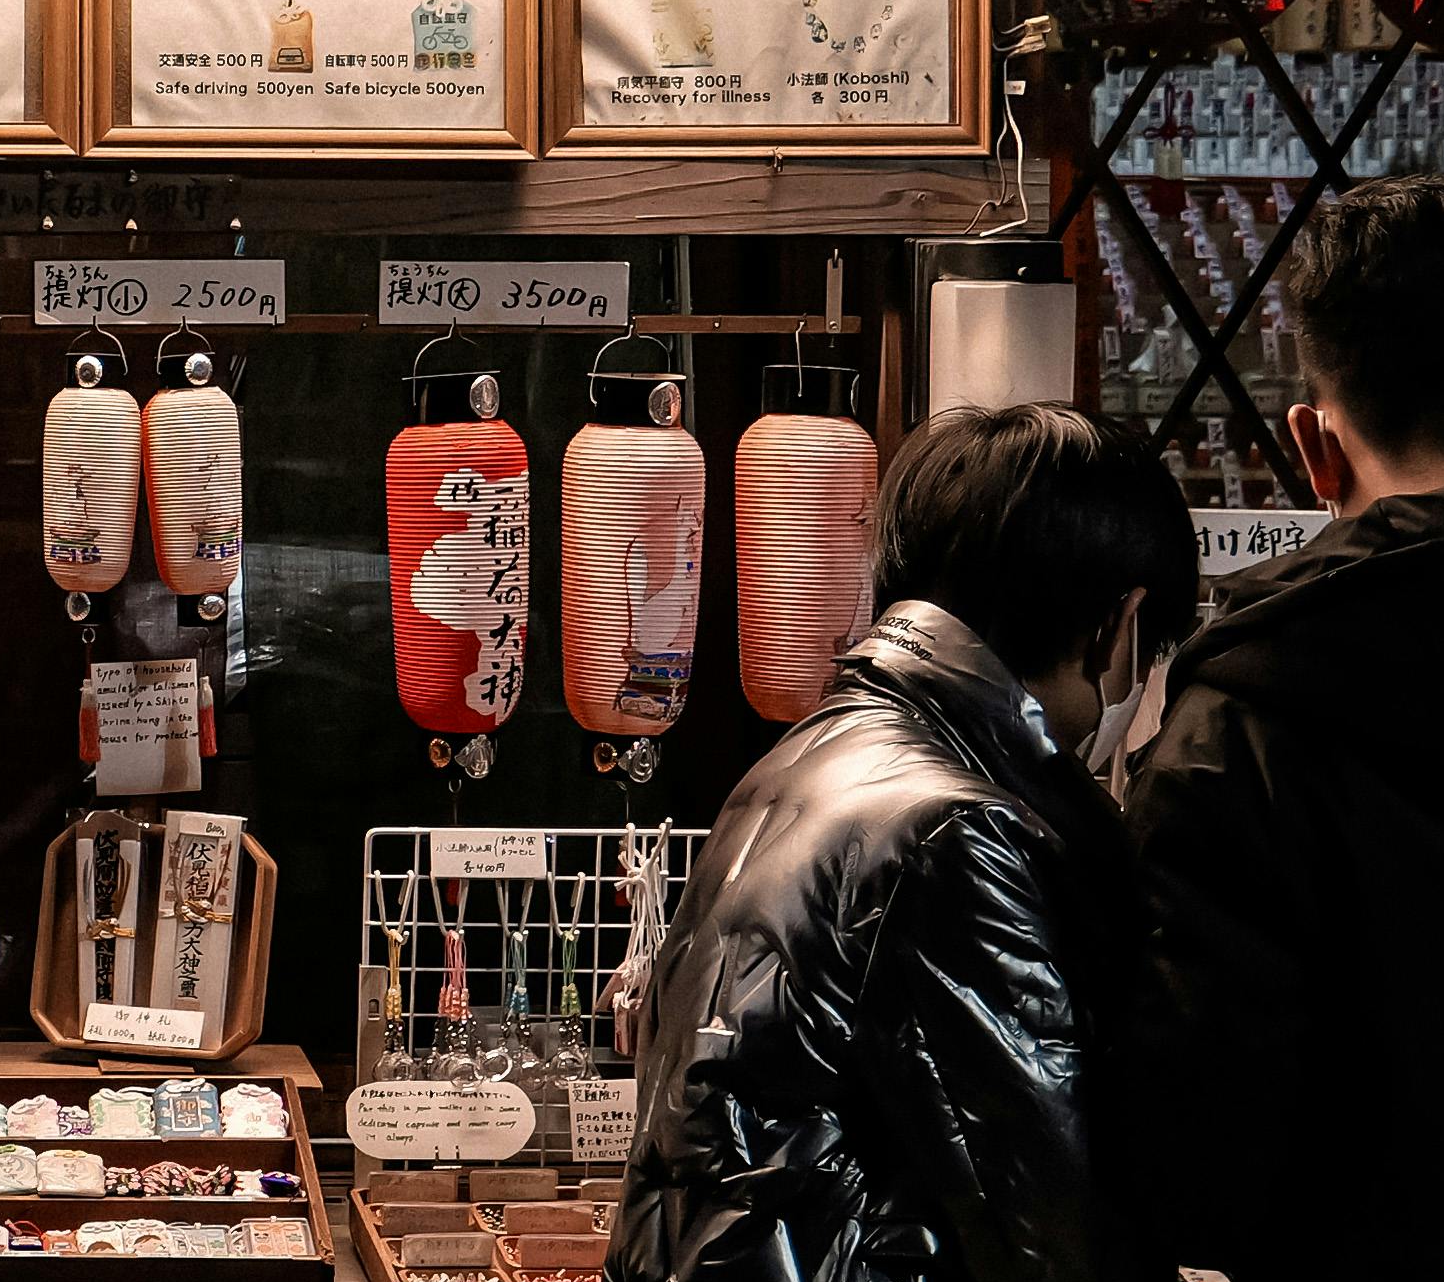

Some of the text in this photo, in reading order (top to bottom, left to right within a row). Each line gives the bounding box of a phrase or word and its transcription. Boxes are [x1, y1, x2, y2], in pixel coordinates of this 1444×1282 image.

[159, 54, 211, 67] 交通安全
[833, 71, 910, 87] (Koboshi)
[156, 82, 313, 96] Safe driving 500yen
[325, 82, 485, 97] Safe bicycle 500yen
[612, 90, 770, 106] Recovery for illness
[172, 283, 276, 317] 2500円
[502, 282, 607, 319] 3500円
